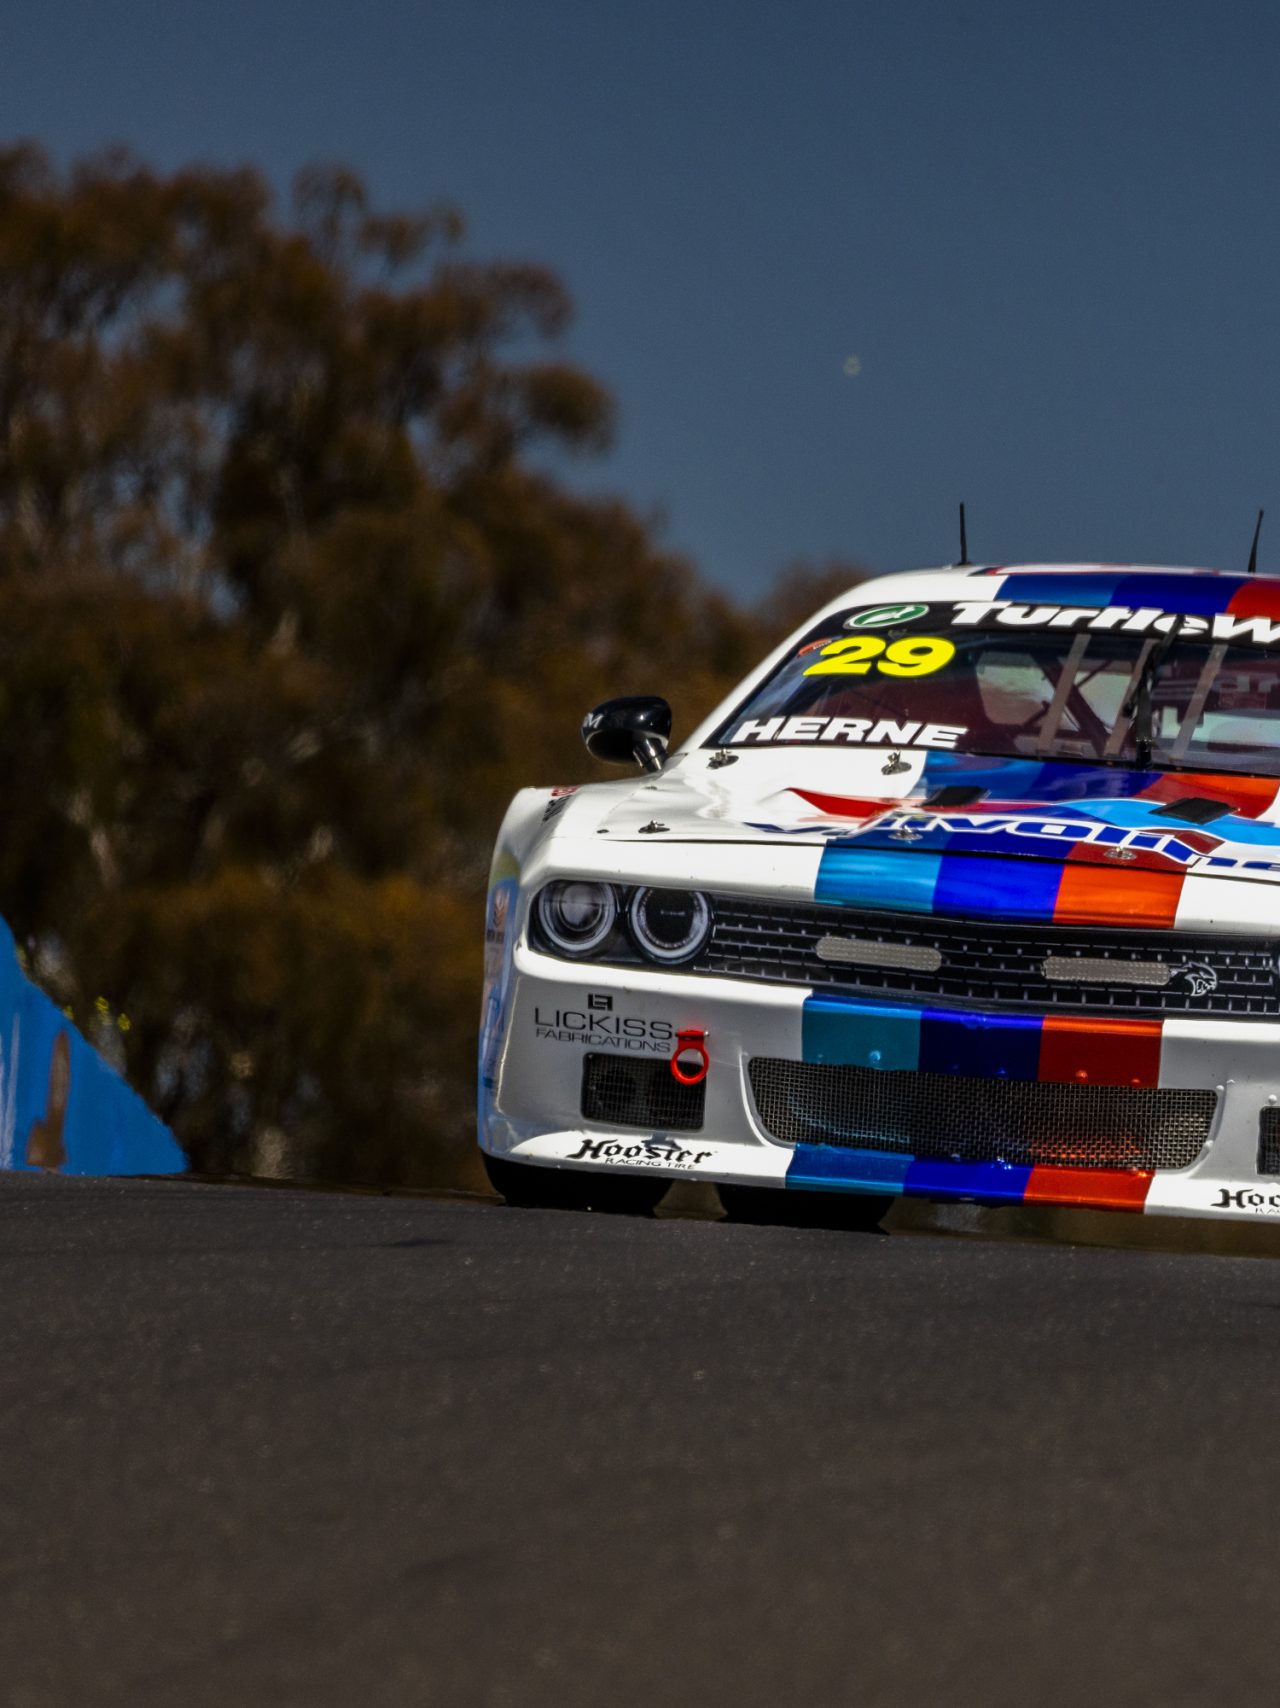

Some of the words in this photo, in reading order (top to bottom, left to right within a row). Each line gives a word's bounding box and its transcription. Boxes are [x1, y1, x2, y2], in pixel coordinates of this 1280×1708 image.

[803, 635, 956, 677] 29
[730, 716, 968, 748] HERNE
[534, 1007, 673, 1040] LICKISS
[535, 1028, 671, 1053] FABRICATIONS
[566, 1138, 713, 1164] Hoosier
[604, 1157, 662, 1168] RACING
